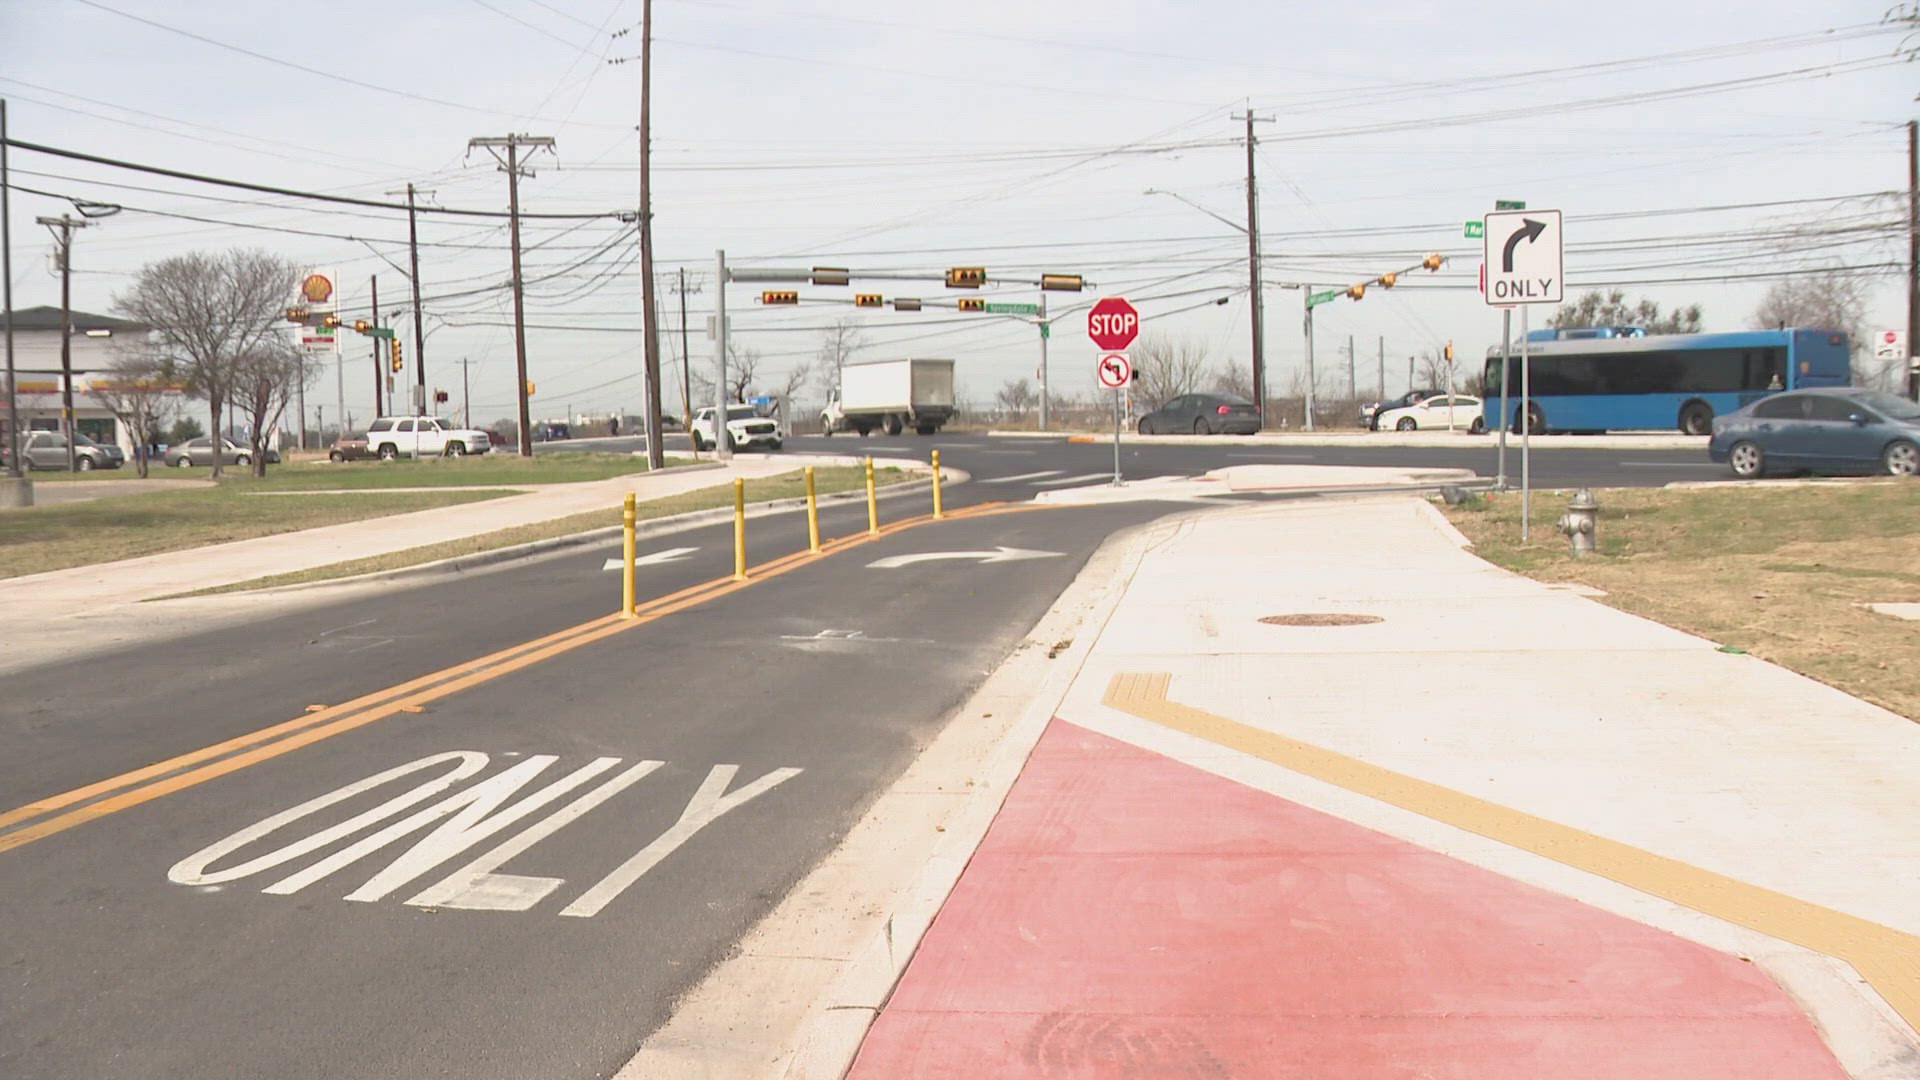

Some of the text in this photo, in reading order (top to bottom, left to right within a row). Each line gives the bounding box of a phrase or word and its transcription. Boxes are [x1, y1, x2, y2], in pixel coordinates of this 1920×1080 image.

[1495, 278, 1552, 298] ONLY
[1090, 313, 1136, 336] STOP
[167, 750, 804, 917] ONLY
